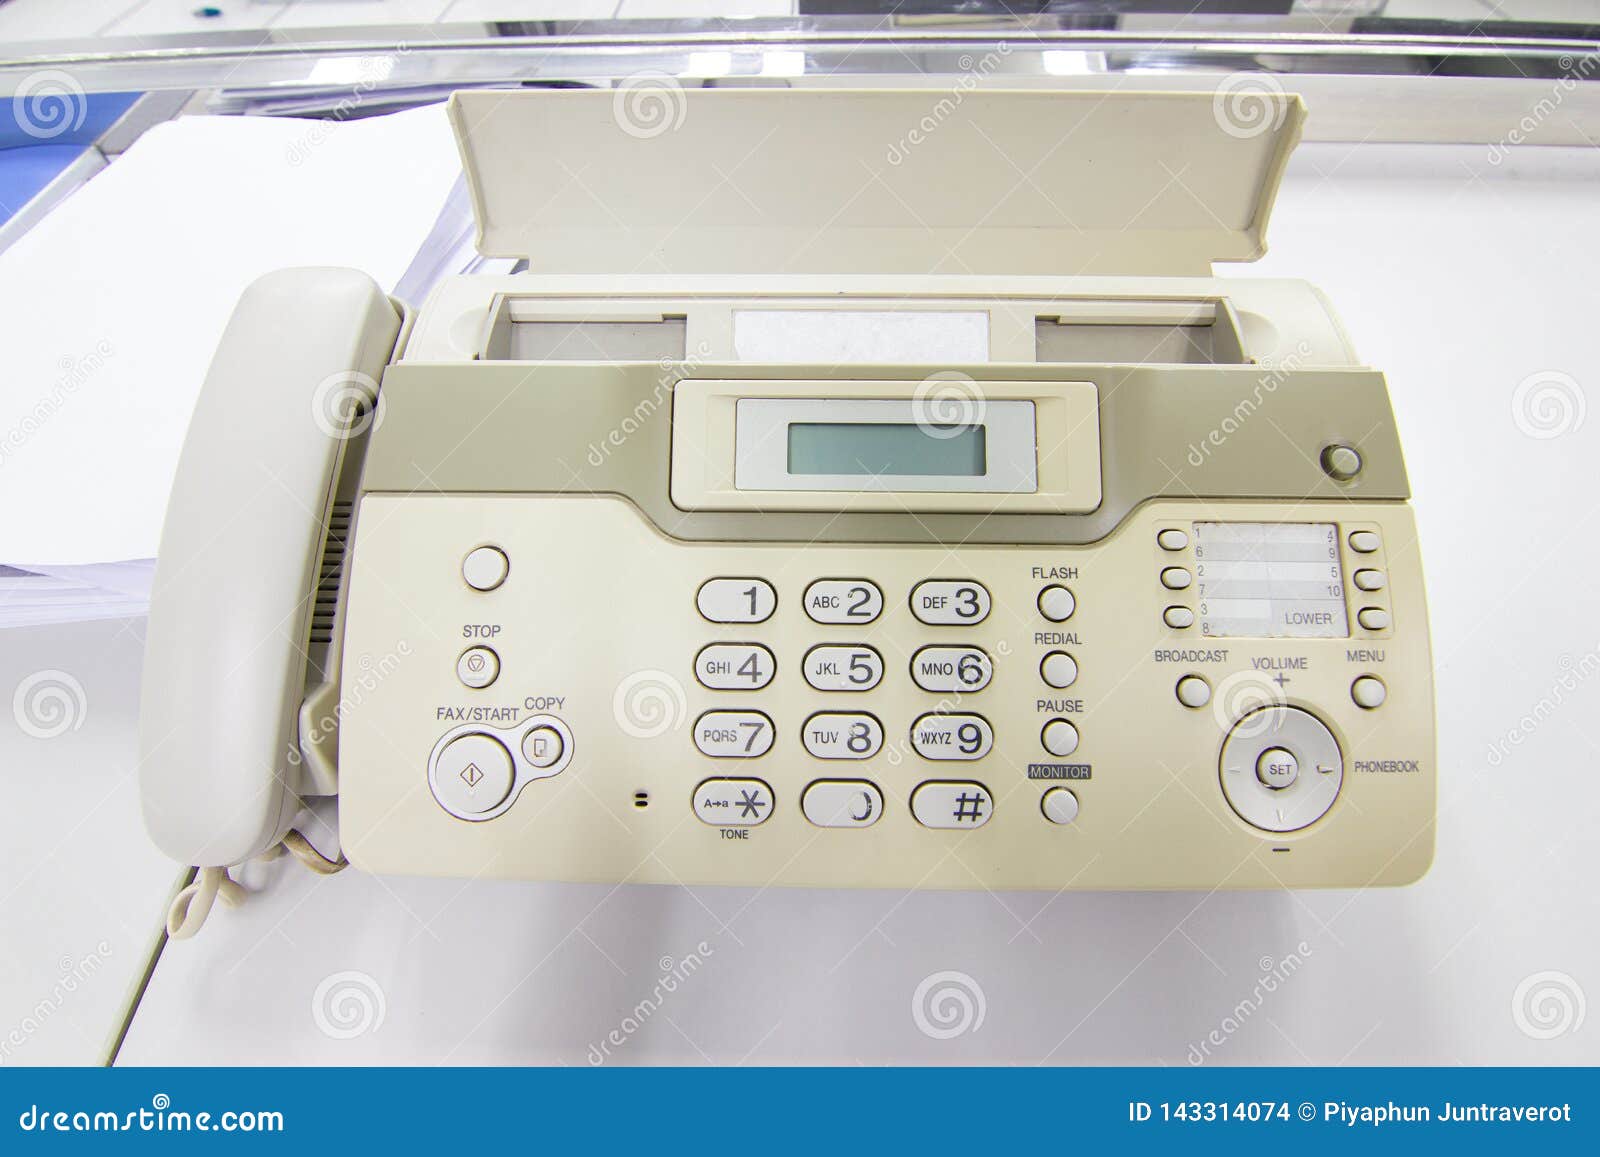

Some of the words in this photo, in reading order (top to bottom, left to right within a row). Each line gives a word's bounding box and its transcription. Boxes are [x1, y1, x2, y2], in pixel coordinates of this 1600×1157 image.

[1196, 546, 1203, 558] 6
[1328, 547, 1336, 559] 9
[1032, 567, 1079, 579] FLASH
[1198, 565, 1205, 577] 2
[1331, 566, 1338, 578] 5
[1200, 584, 1206, 596] 7
[1327, 585, 1341, 597] 10
[743, 586, 757, 616] 1
[812, 596, 840, 608] ABC
[847, 587, 871, 616] 2
[922, 597, 948, 609] DEF
[955, 588, 980, 618] 3
[1201, 603, 1208, 615] 3
[1285, 612, 1333, 625] LOWER
[462, 624, 501, 638] STOP
[1202, 622, 1209, 634] 8
[1034, 632, 1082, 645] REDIAL
[1154, 650, 1229, 662] BROADCAST
[1346, 650, 1385, 662] MENU
[706, 661, 731, 675] GHI
[736, 652, 763, 683] 4
[815, 663, 841, 676] JKL
[848, 654, 873, 684] 5
[921, 663, 953, 676] MNO
[957, 653, 983, 685] 6
[1251, 657, 1308, 669] VOLUME
[524, 696, 565, 710] COPY
[1037, 699, 1084, 713] PAUSE
[436, 706, 520, 721] FAX/START
[703, 729, 738, 743] PQRS
[739, 722, 765, 752] 7
[812, 731, 839, 744] TUV
[847, 722, 872, 753] 8
[920, 732, 952, 745] WXYZ
[957, 723, 982, 754] 9
[1030, 766, 1089, 778] MONITOR
[1269, 764, 1292, 775] SET
[1354, 760, 1420, 773] PHONEBOOK
[719, 829, 749, 840] TONE
